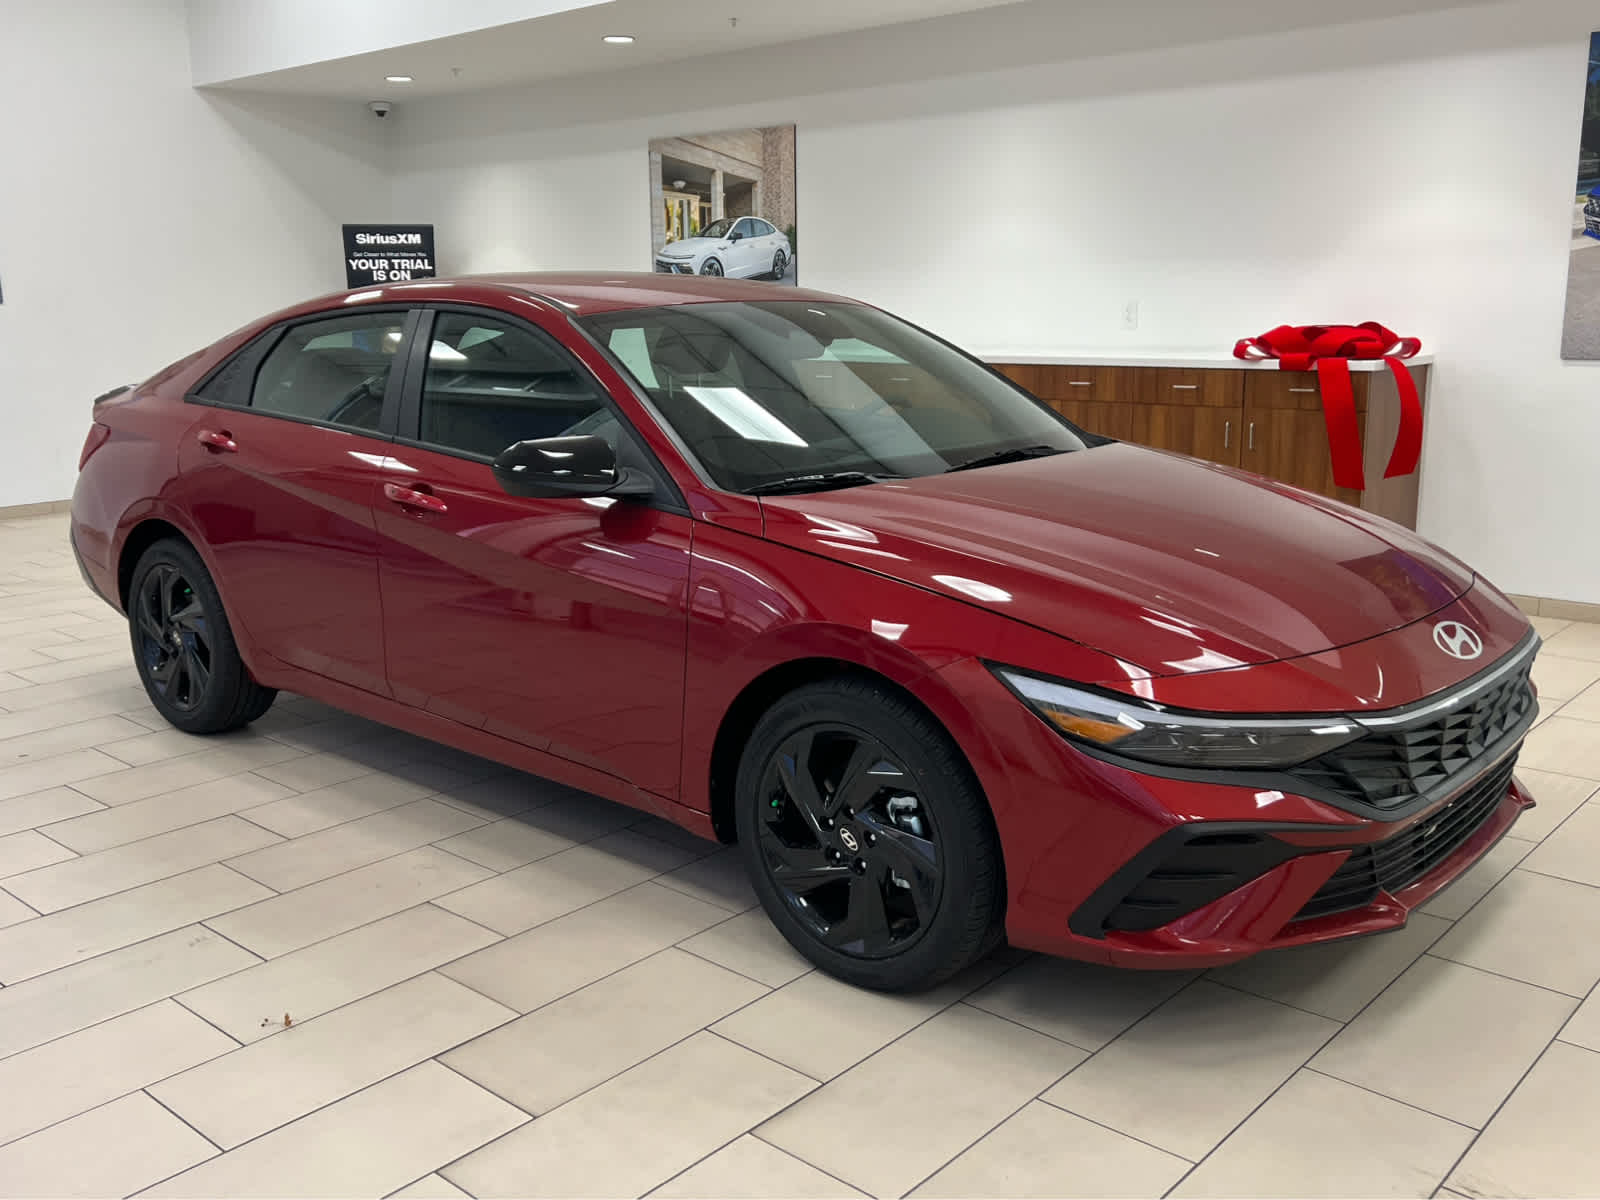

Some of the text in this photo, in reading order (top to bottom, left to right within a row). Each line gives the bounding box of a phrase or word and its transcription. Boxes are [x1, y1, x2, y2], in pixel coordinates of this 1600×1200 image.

[355, 233, 422, 244] SiriusXM
[348, 259, 433, 270] YOUR TRIAL
[372, 270, 411, 281] IS ON
